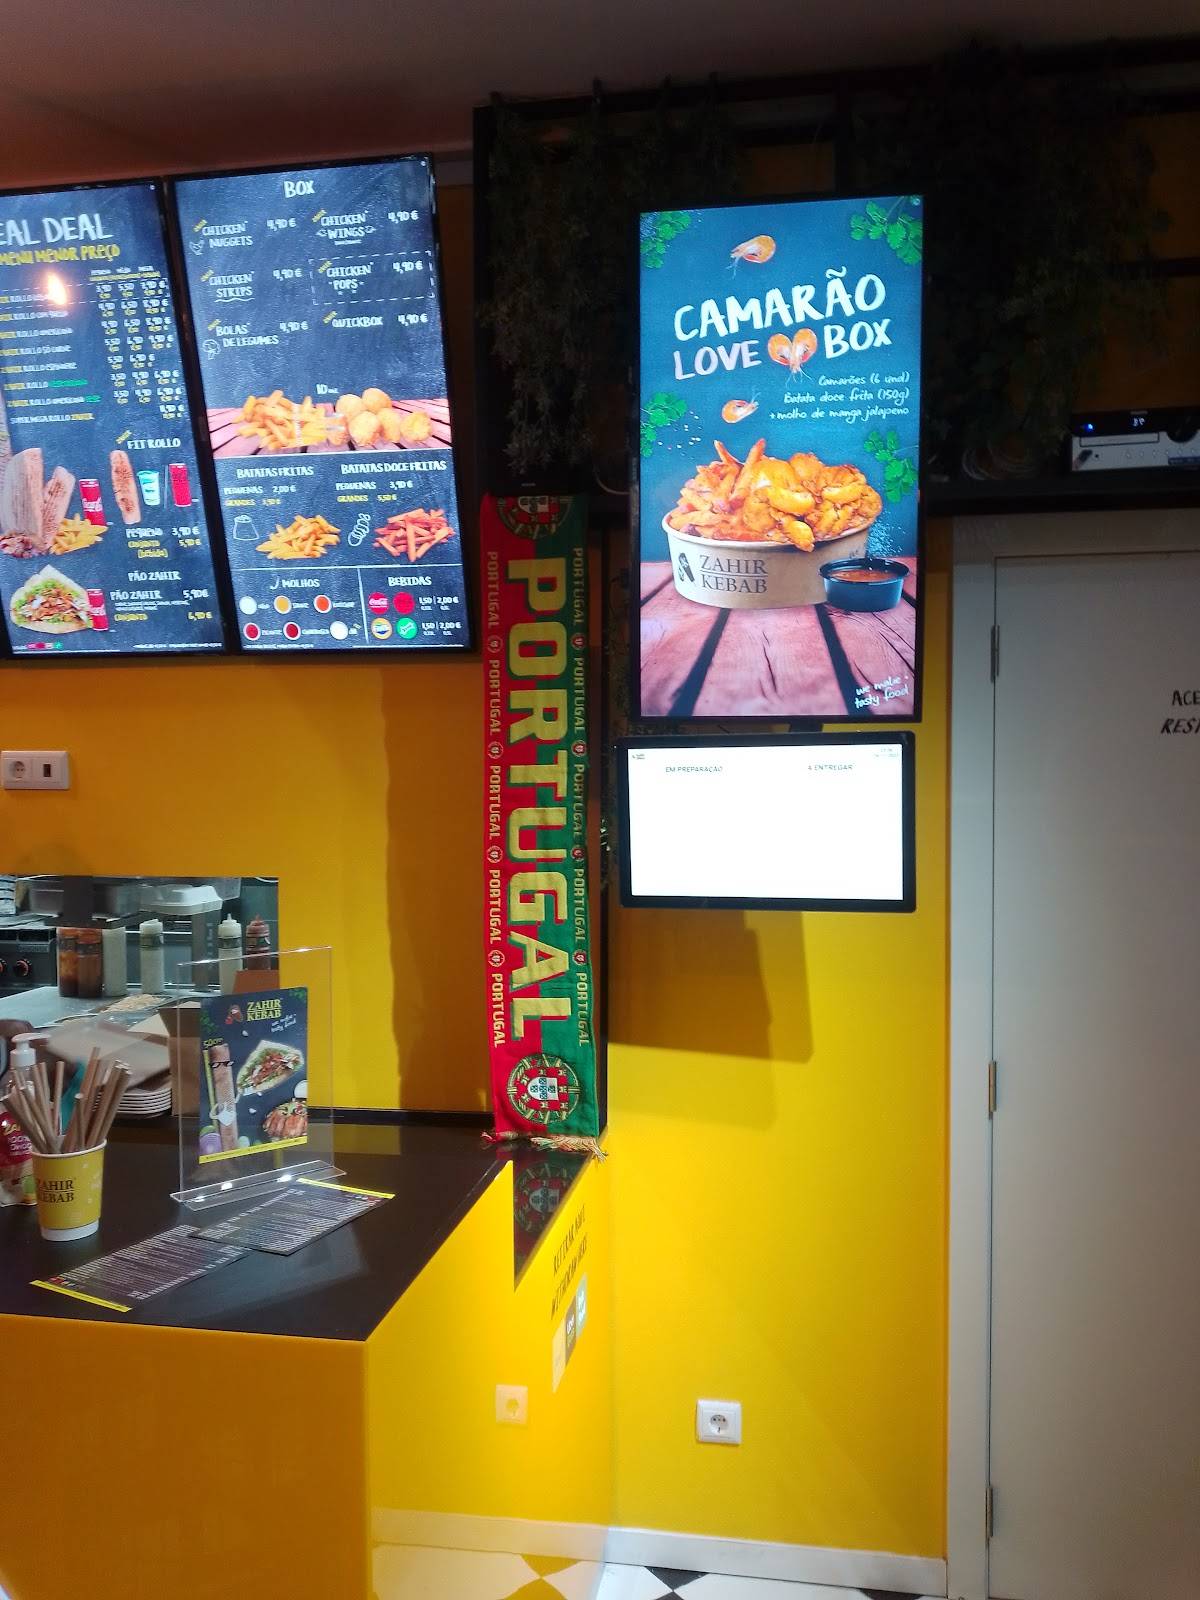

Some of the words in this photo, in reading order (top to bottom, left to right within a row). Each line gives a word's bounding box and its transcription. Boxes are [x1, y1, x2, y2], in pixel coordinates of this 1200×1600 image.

[284, 180, 315, 198] BOX
[42, 213, 114, 243] DEAL
[321, 213, 366, 226] CHICKEN
[202, 224, 246, 236] CHICKEN
[328, 226, 365, 239] WINGS
[209, 236, 253, 248] NUGGETS
[34, 246, 79, 263] MENOR
[80, 244, 120, 262] PREÇO
[327, 264, 372, 277] CHICKEN
[209, 274, 252, 286] CHICKEN
[333, 279, 358, 290] POPS
[216, 286, 253, 298] STRIPS
[674, 266, 886, 341] CAMARÃO
[216, 324, 248, 336] BOLAS
[332, 316, 383, 328] QUICKBOX
[236, 335, 279, 346] LEGUMES
[673, 340, 762, 381] LOVE
[823, 318, 892, 359] BOX
[818, 374, 866, 386] Camarões
[784, 392, 816, 404] Batata
[820, 391, 845, 402] doce
[849, 387, 874, 401] frita
[877, 387, 910, 406] (150g)
[811, 407, 825, 418] de
[829, 409, 862, 424] manga
[127, 439, 147, 450] FIT
[149, 438, 181, 448] ROLLO
[236, 467, 278, 479] BATATAS
[278, 466, 314, 477] FRITAS
[341, 463, 383, 474] BATATAS
[384, 462, 409, 472] DOCE
[409, 461, 447, 471] FRITAS
[699, 555, 768, 575] ZAHIR
[128, 570, 147, 581] PÃO
[148, 571, 181, 581] ZAHIR
[282, 578, 320, 589] MOLHOS
[388, 576, 432, 587] BEBIDAS
[487, 551, 500, 629] PORTUGAL
[573, 547, 584, 626] PORTUGAL
[700, 575, 768, 594] KEBAB
[110, 589, 129, 600] PÃO
[129, 590, 163, 599] ZAHIR
[856, 686, 870, 696] we
[874, 676, 900, 690] make
[489, 659, 501, 736] PORTUGAL
[573, 657, 585, 735] PORTUGAL
[855, 694, 879, 709] tasty
[884, 684, 908, 701] food
[489, 765, 501, 841] PORTUGAL
[506, 557, 572, 1038] PORTUGAL
[573, 764, 585, 840] PORTUGAL
[490, 869, 501, 943] PORTUGAL
[573, 869, 586, 942] PORTUGAL
[247, 999, 281, 1010] ZAHIR
[492, 973, 506, 1047] PORTUGAL
[576, 973, 590, 1047] PORTUGAL
[247, 1009, 281, 1021] KEBAB
